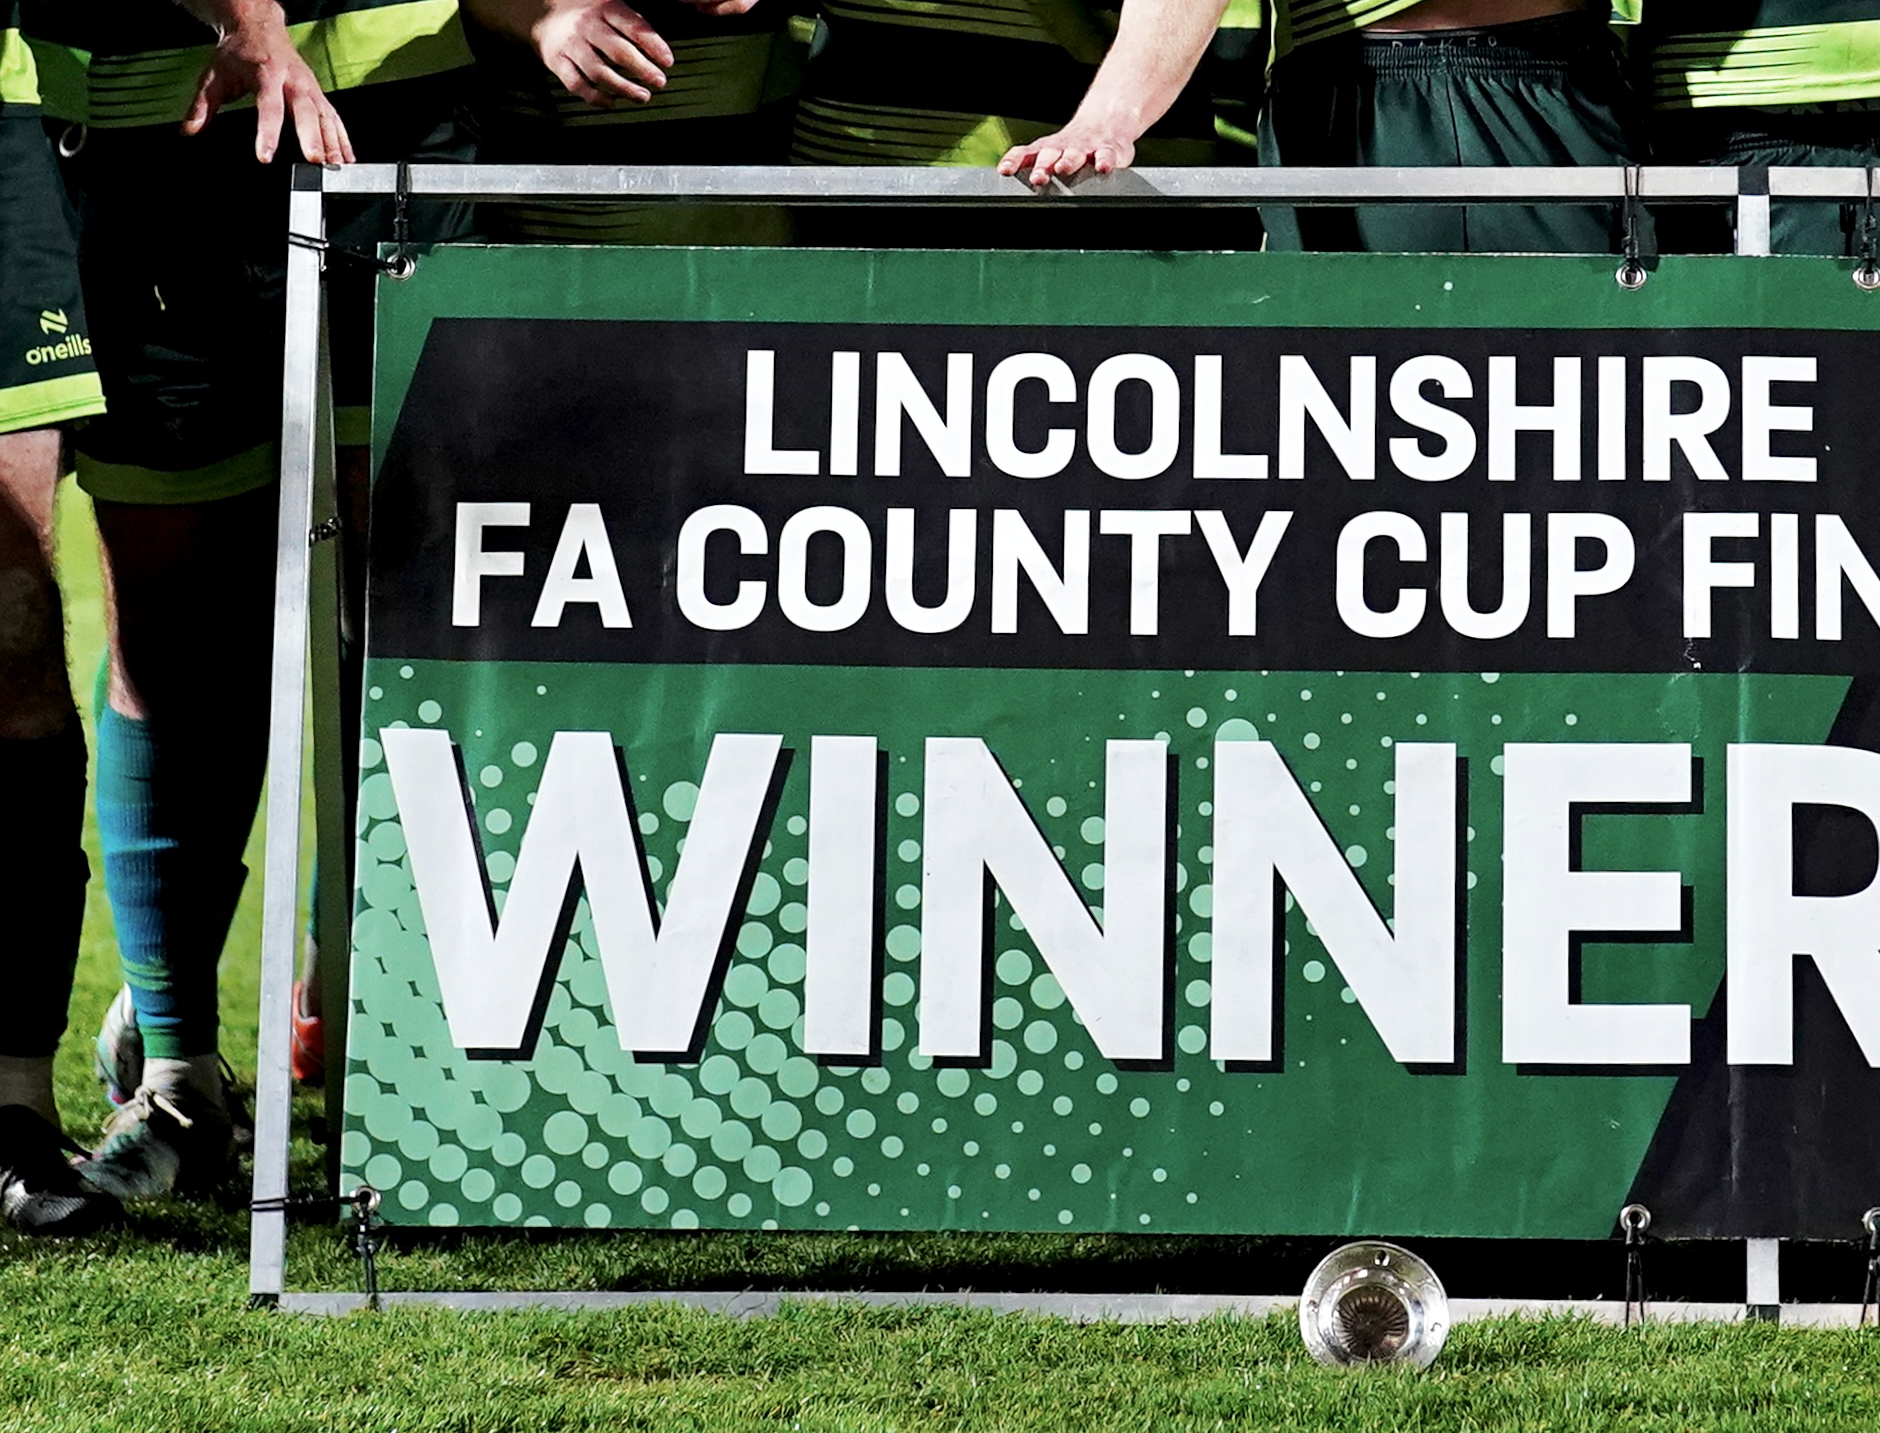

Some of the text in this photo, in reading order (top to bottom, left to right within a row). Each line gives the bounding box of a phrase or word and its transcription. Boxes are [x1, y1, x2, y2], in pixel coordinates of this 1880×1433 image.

[743, 349, 1819, 483] LINCOLNSHIRE
[451, 502, 633, 630] FA
[675, 504, 1295, 637] COUNTY
[1335, 511, 1637, 640] CUP
